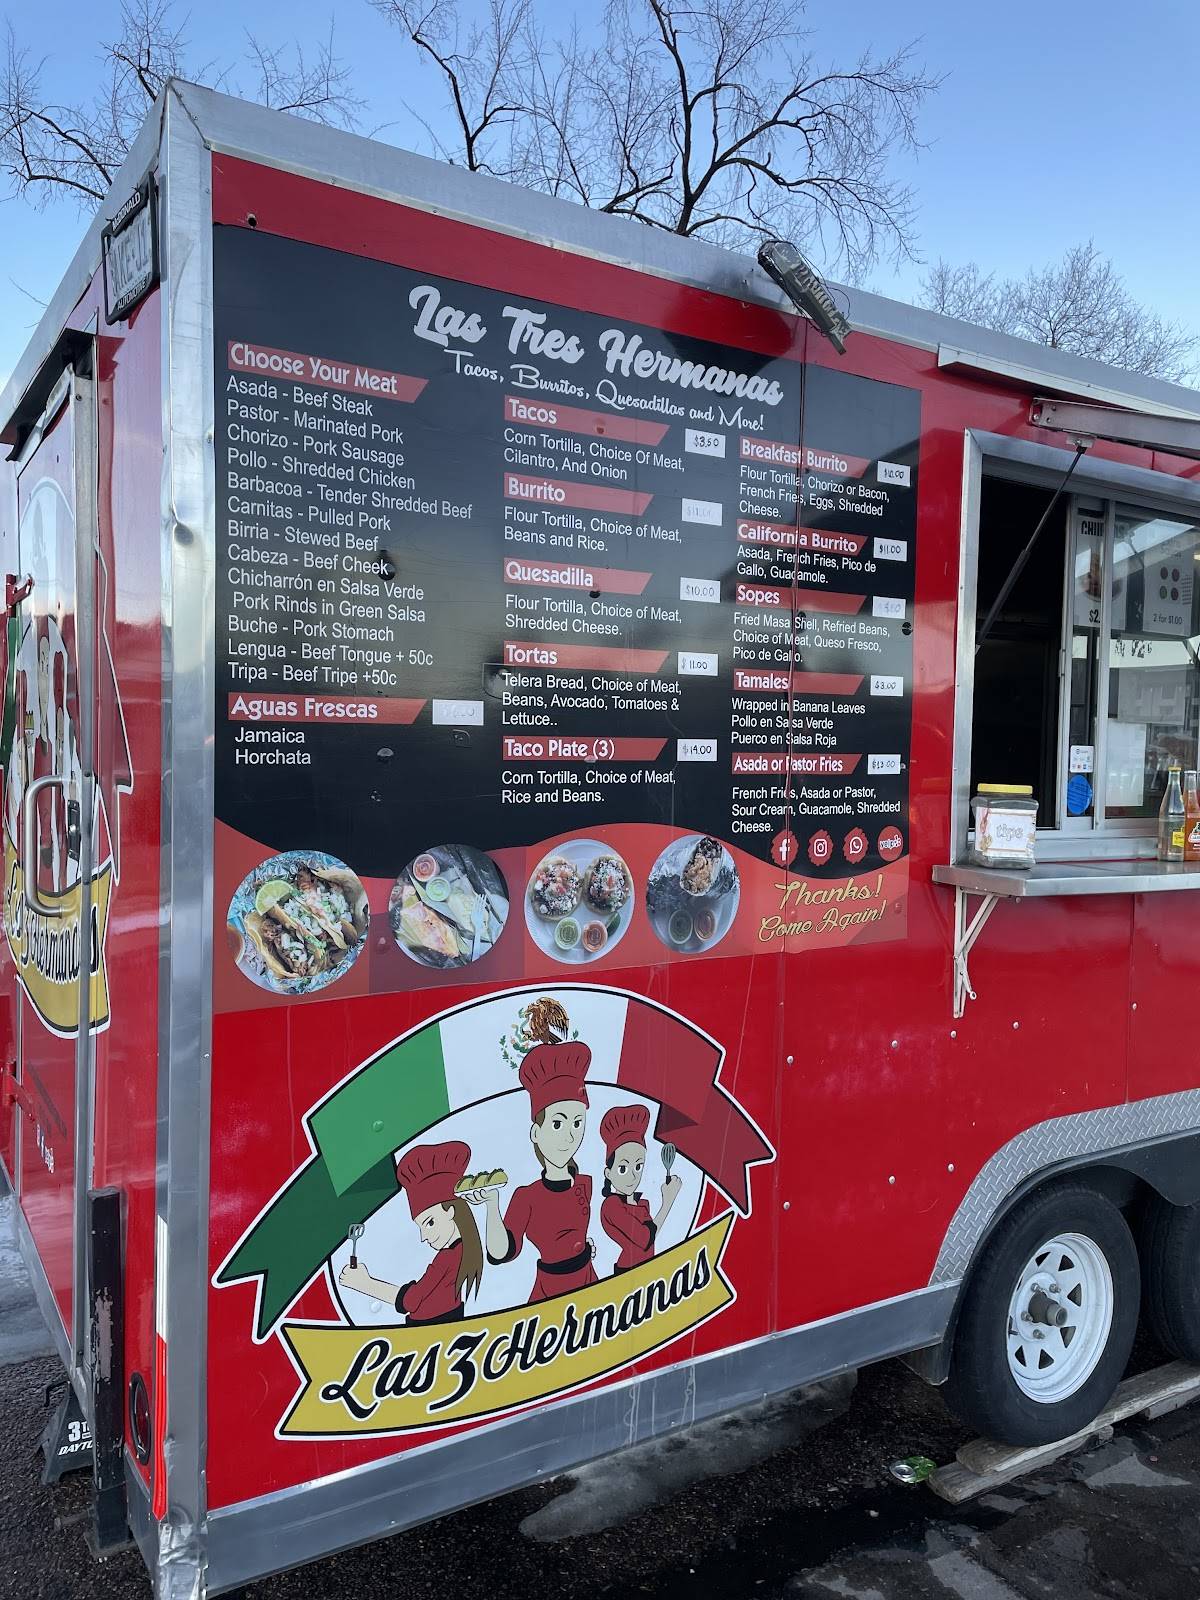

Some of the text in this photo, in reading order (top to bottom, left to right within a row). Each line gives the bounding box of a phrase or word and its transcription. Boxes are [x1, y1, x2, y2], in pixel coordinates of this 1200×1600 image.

[409, 285, 783, 406] Las Tres Hermanas
[230, 343, 398, 394] Choose Your Meat
[227, 375, 373, 416] Asada Beef Steak
[444, 349, 764, 431] Tacos, Burritos, Quesadillas More!
[228, 400, 403, 444] Pastor Marinated Pork
[509, 399, 557, 424] Tacos
[228, 424, 404, 468] Chorizo Pork Sausage
[504, 428, 685, 472] Corn Tortilla, Choice Meat,
[228, 448, 415, 489] Pollo Shredded Chicken
[504, 448, 627, 480] Cilantro, And Onion
[807, 451, 847, 472] Burrito
[228, 472, 472, 519] Barbacoa Tender Shredded Beef
[509, 478, 565, 501] Burrito
[740, 465, 889, 502] Flour Chorizo Bacon,
[740, 483, 883, 516] French Eggs, Shredded
[740, 501, 782, 518] Cheese.
[228, 496, 391, 530] Carnitas Pulled Pork
[505, 506, 682, 543] Flour Tortilla, Choice Meat,
[228, 520, 378, 551] Birria Stewed Beef
[505, 527, 608, 551] Beans Rice.
[738, 524, 857, 552] California Burrito
[228, 544, 388, 575] Cabeza Beef Cheek
[737, 545, 861, 571] Asada, Fries, Pico
[737, 562, 766, 578] Gallo,
[228, 568, 424, 600] Chicharrón Salsa Verde
[506, 561, 593, 587] Quesadilla
[233, 592, 425, 622] Pork Rinds Green Salsa
[737, 585, 779, 605] Sopes
[229, 615, 394, 641] Buche Pork Stomach
[506, 614, 622, 635] Shredded Cheese.
[734, 612, 890, 637] Fried Masa Shell, Refried Beans,
[228, 639, 433, 666] Lengua Beef Tongue 50c
[733, 647, 755, 659] Pico
[734, 630, 882, 652] Choice Queso Fresco,
[506, 645, 558, 664] Tortas
[228, 663, 397, 686] Tripa Beef Tripe +50c
[502, 673, 681, 695] Telera Bread, Choice Meat,
[736, 672, 788, 689] Tamales
[231, 696, 378, 720] Aguas Frescas
[502, 692, 667, 710] Beans, Avocado, Tomatoes
[732, 698, 865, 713] Wrapped Banana Leaves
[731, 715, 833, 729] Pollo Verde
[235, 727, 305, 743] Jamaica
[731, 732, 836, 747] Puerco Roja
[236, 749, 311, 764] Horchata
[505, 739, 614, 759] Taco Plate (3)
[734, 756, 843, 771] Asada Fries
[502, 789, 604, 803] Rice Beans.
[733, 786, 876, 799] French Asada Pastor,
[732, 801, 900, 816] Sour Guacamole, Shredded
[732, 821, 773, 832] Cheese.
[775, 874, 883, 910] Thanks!
[759, 900, 886, 941] Come Again!
[322, 1245, 710, 1419] Las 3 Hermanas
[68, 1421, 80, 1442] 3
